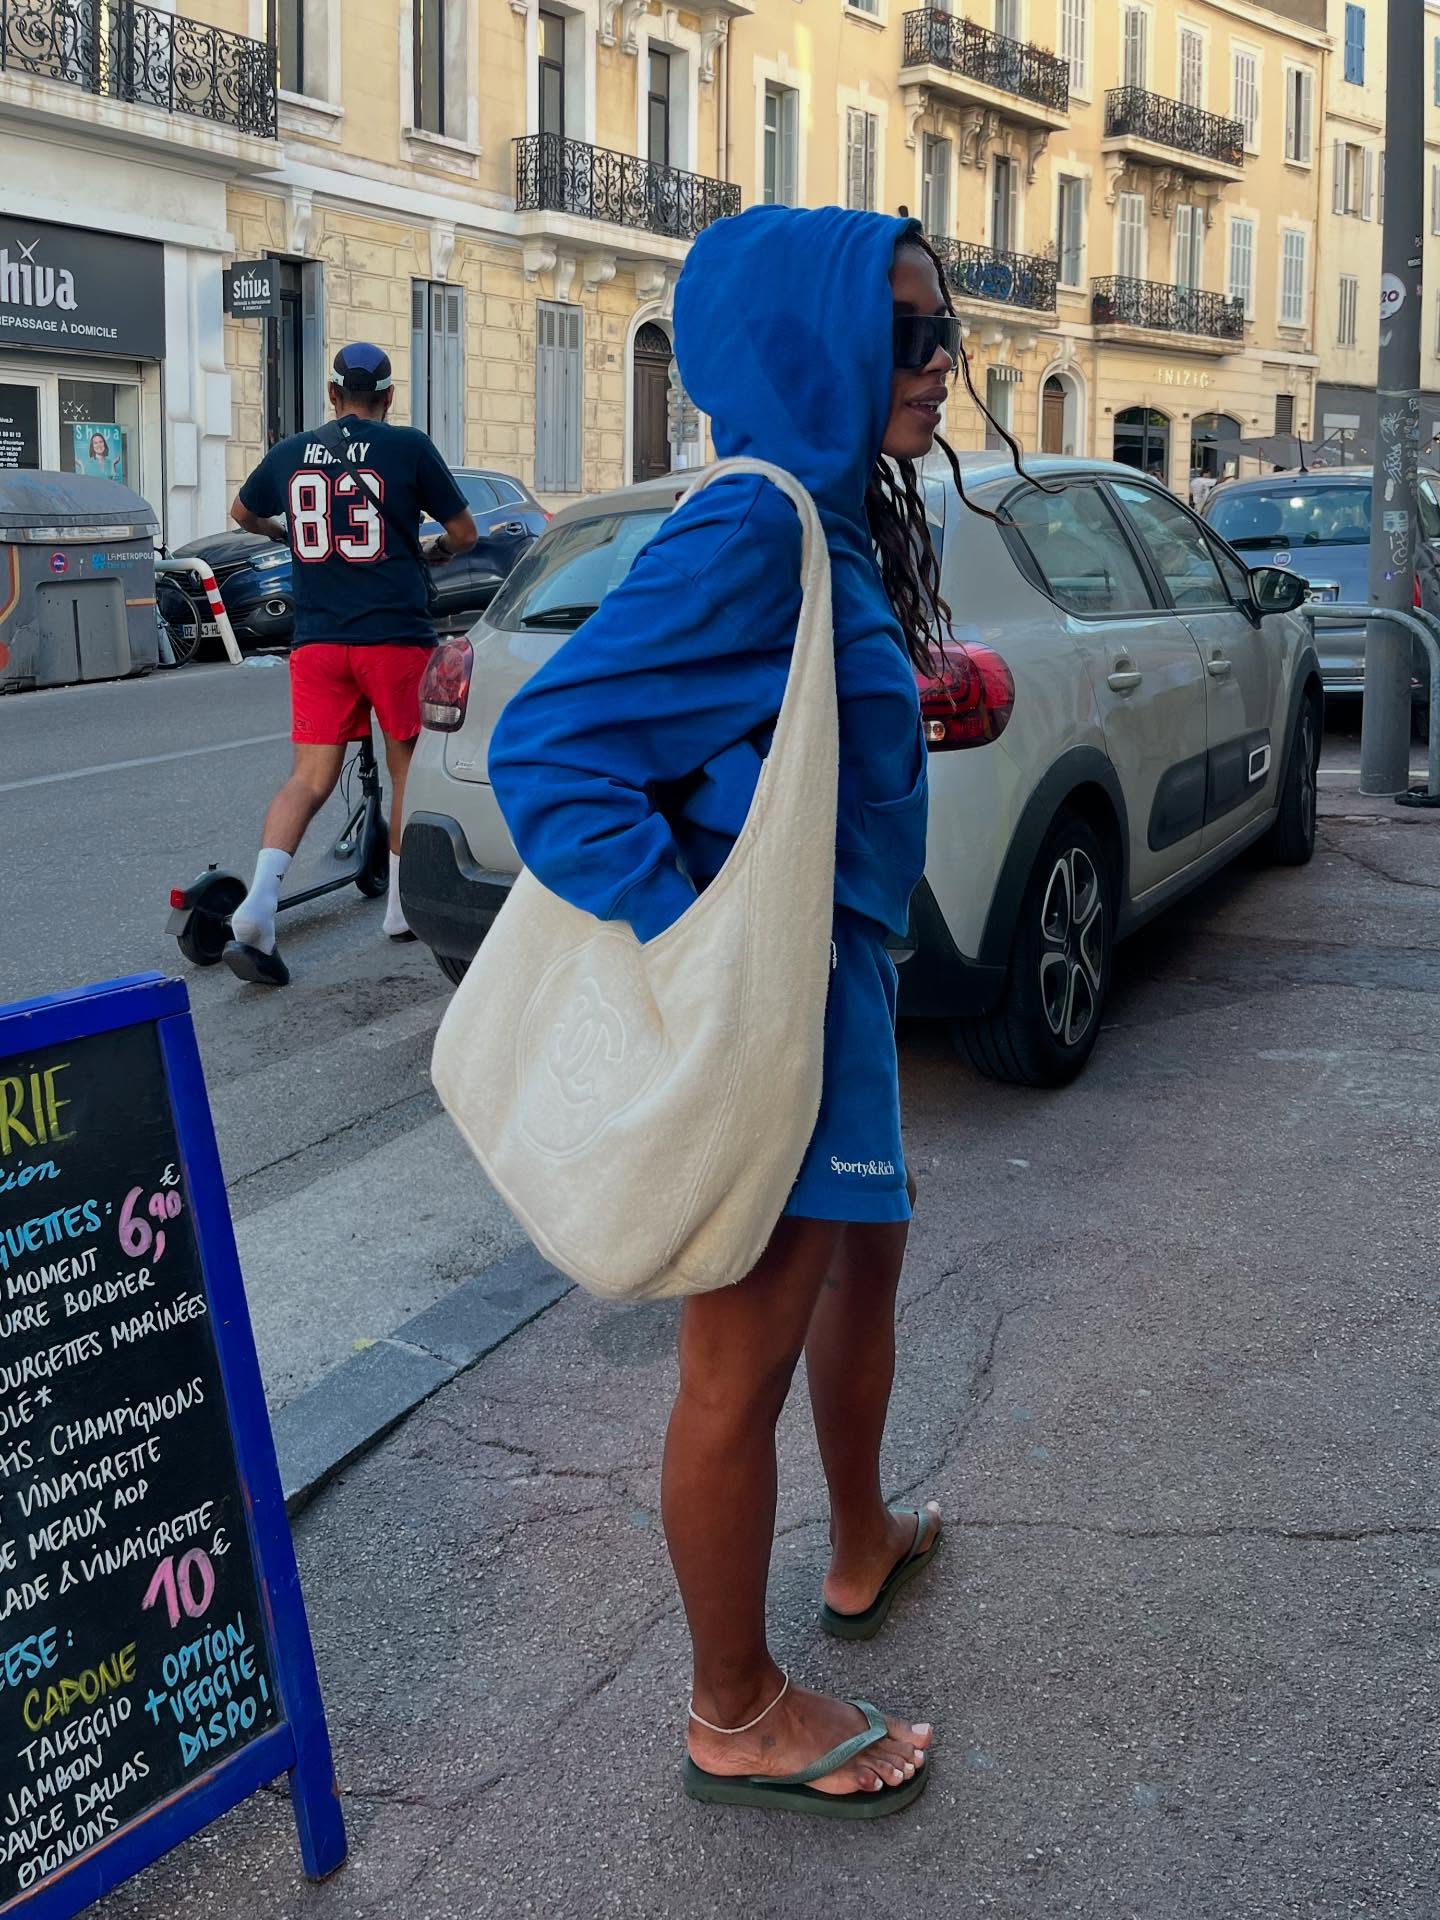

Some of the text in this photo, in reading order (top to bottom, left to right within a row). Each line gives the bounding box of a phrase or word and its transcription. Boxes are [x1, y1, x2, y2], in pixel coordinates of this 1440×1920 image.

[233, 267, 271, 299] shiva
[0, 315, 118, 338] EPASSAGE À DOMICILE
[288, 469, 385, 563] 83
[0, 1062, 77, 1156] RIE
[830, 1155, 895, 1177] Sporty&Rich
[6, 1246, 98, 1300] MOMENT
[64, 1268, 156, 1317] BORDIER
[110, 1291, 207, 1349] MARINÉES
[50, 1376, 205, 1456] CHAMPIGNONS
[17, 1436, 161, 1518] VINAIGRETTE
[28, 1500, 107, 1560] MEAUX
[114, 1478, 149, 1510] AOP
[59, 1560, 80, 1594] &
[80, 1500, 214, 1582] VINAIGRETTE
[23, 1641, 137, 1733] CAPONE
[162, 1611, 246, 1687] OPTION
[17, 1696, 132, 1773] TALEGGIO
[4, 1744, 103, 1826] JAMBON
[17, 1803, 119, 1890] OIGNONS
